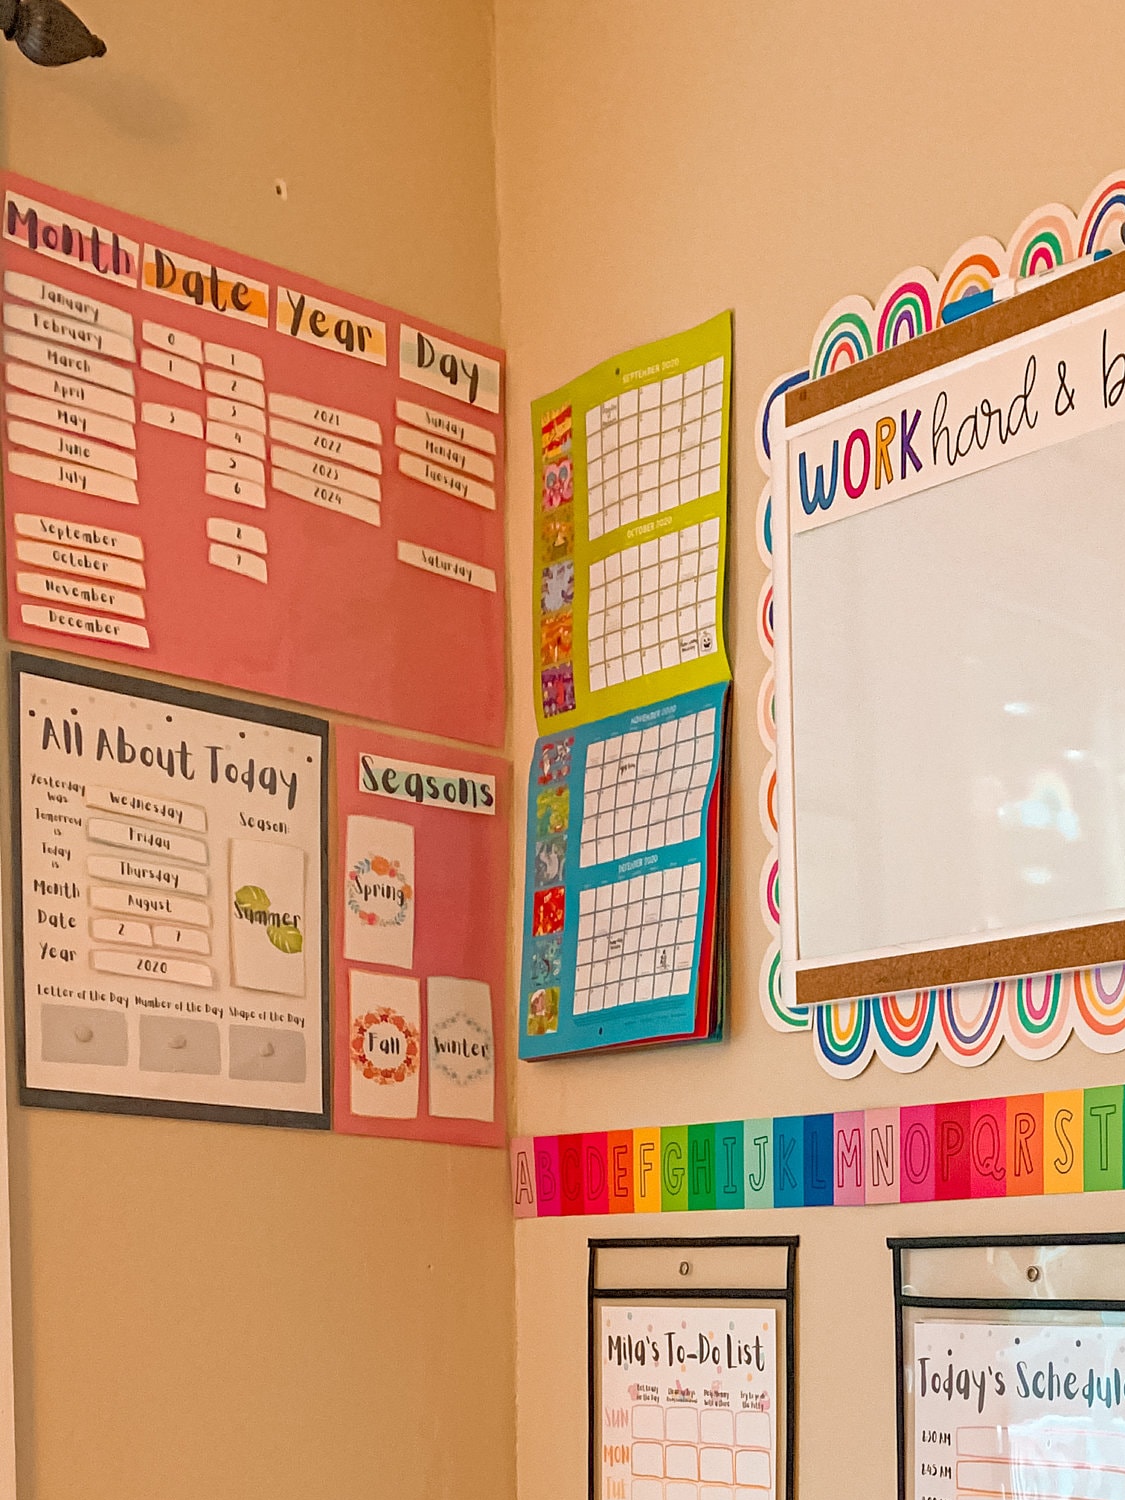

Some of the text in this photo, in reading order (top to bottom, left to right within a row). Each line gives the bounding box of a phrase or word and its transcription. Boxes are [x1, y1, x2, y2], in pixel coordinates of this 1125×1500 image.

[7, 200, 130, 274] Month
[155, 249, 252, 312] Date
[41, 285, 99, 322] January
[34, 313, 102, 350] February
[286, 290, 372, 352] Year
[47, 349, 91, 372] March
[417, 332, 479, 404] Day
[53, 380, 84, 400] April
[57, 409, 87, 432] May
[58, 438, 90, 458] June
[798, 407, 924, 517] WORK
[931, 355, 1039, 467] hard
[1053, 360, 1076, 416] &
[59, 466, 87, 490] July
[40, 519, 117, 547] September
[52, 550, 109, 571] October
[46, 579, 115, 604] November
[49, 610, 120, 635] December
[42, 717, 298, 810] All About Today
[31, 773, 86, 797] Yesterday
[361, 754, 494, 809] Seasons
[109, 792, 183, 824] Wednesday
[129, 827, 170, 850] Friday
[42, 842, 70, 861] Today
[120, 861, 179, 887] Thursday
[33, 879, 80, 898] Month
[354, 875, 405, 907] Spring
[128, 894, 172, 913] August
[234, 900, 301, 927] Summer
[37, 908, 76, 929] Date
[40, 942, 77, 962] Year
[137, 959, 168, 974] 2020
[368, 1031, 400, 1055] Fall
[433, 1035, 489, 1059] Winter
[608, 1332, 765, 1371] Mila's To-Do List
[918, 1357, 1006, 1413] Today's
[604, 1445, 629, 1467] MON
